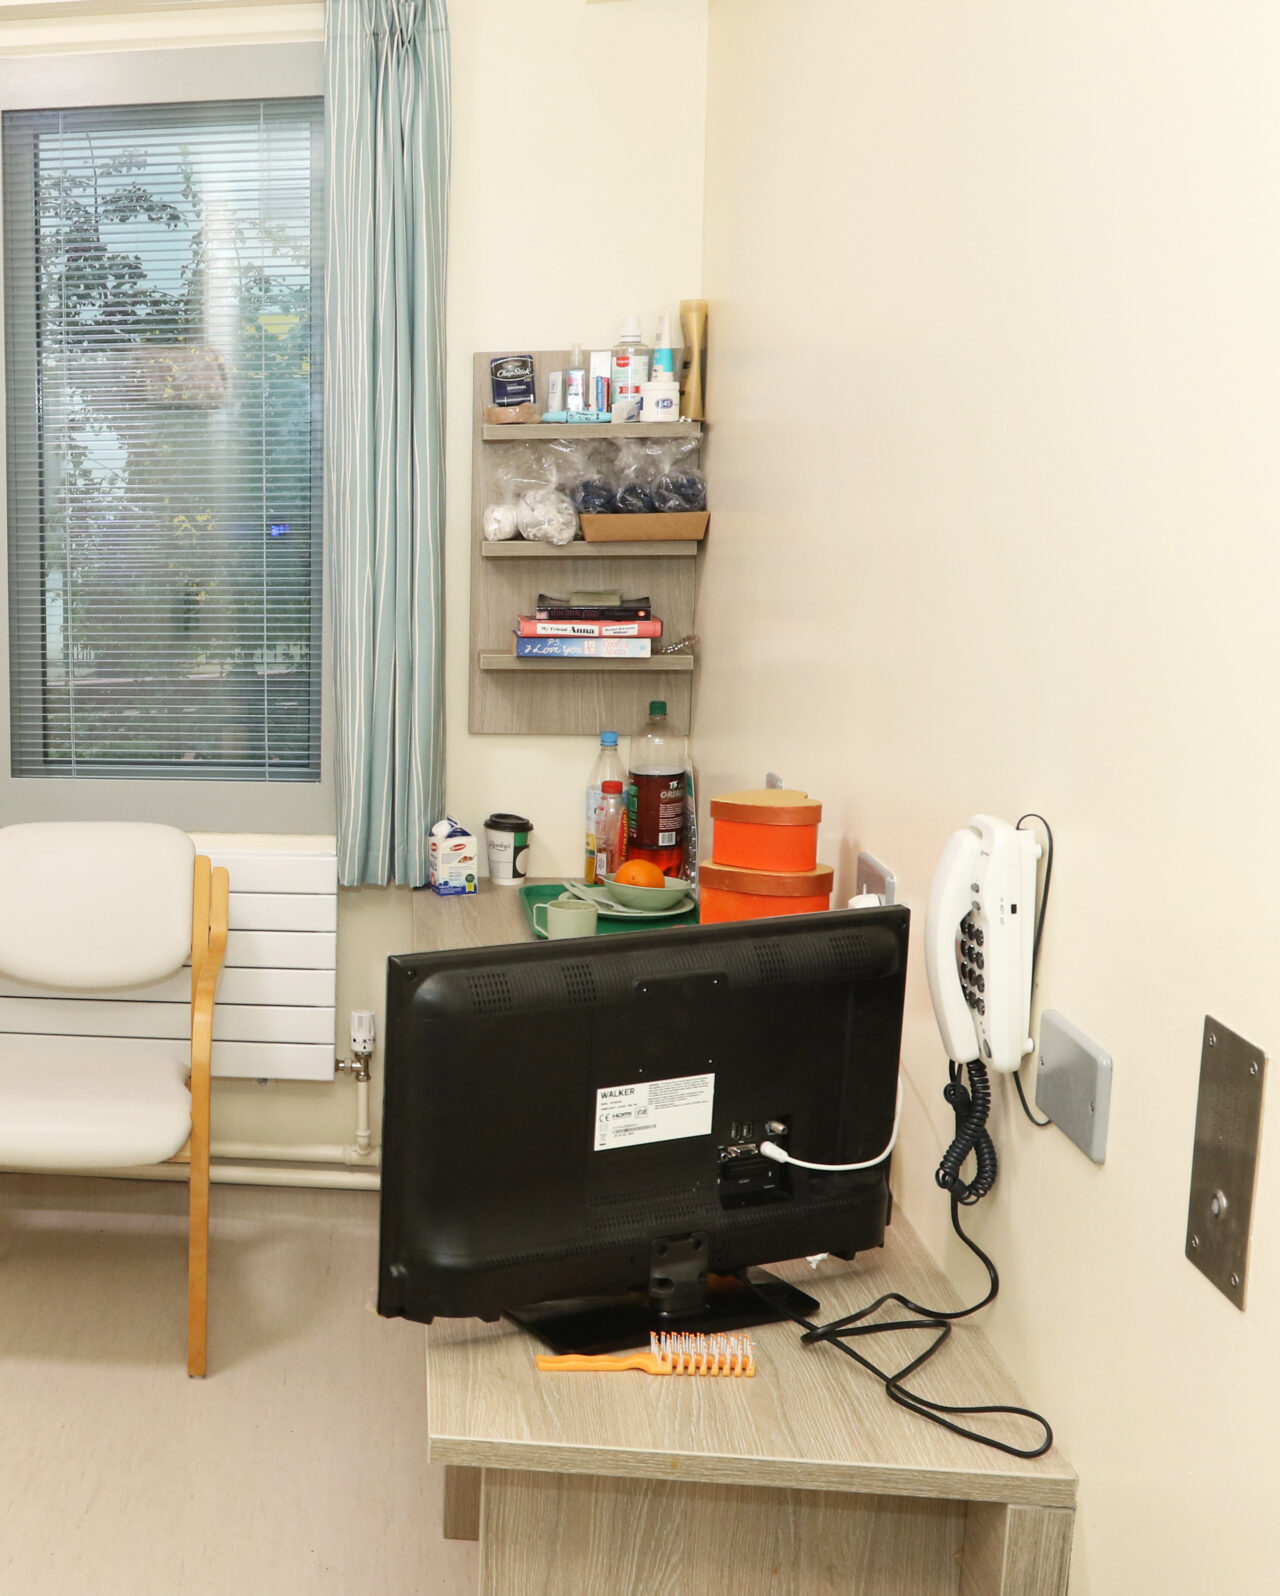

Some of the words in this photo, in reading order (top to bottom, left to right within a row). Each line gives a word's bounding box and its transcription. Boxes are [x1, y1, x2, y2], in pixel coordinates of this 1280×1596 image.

[496, 367, 532, 378] ChapStick
[571, 626, 595, 634] Anna
[532, 644, 561, 655] Love
[601, 1087, 635, 1099] WALKER
